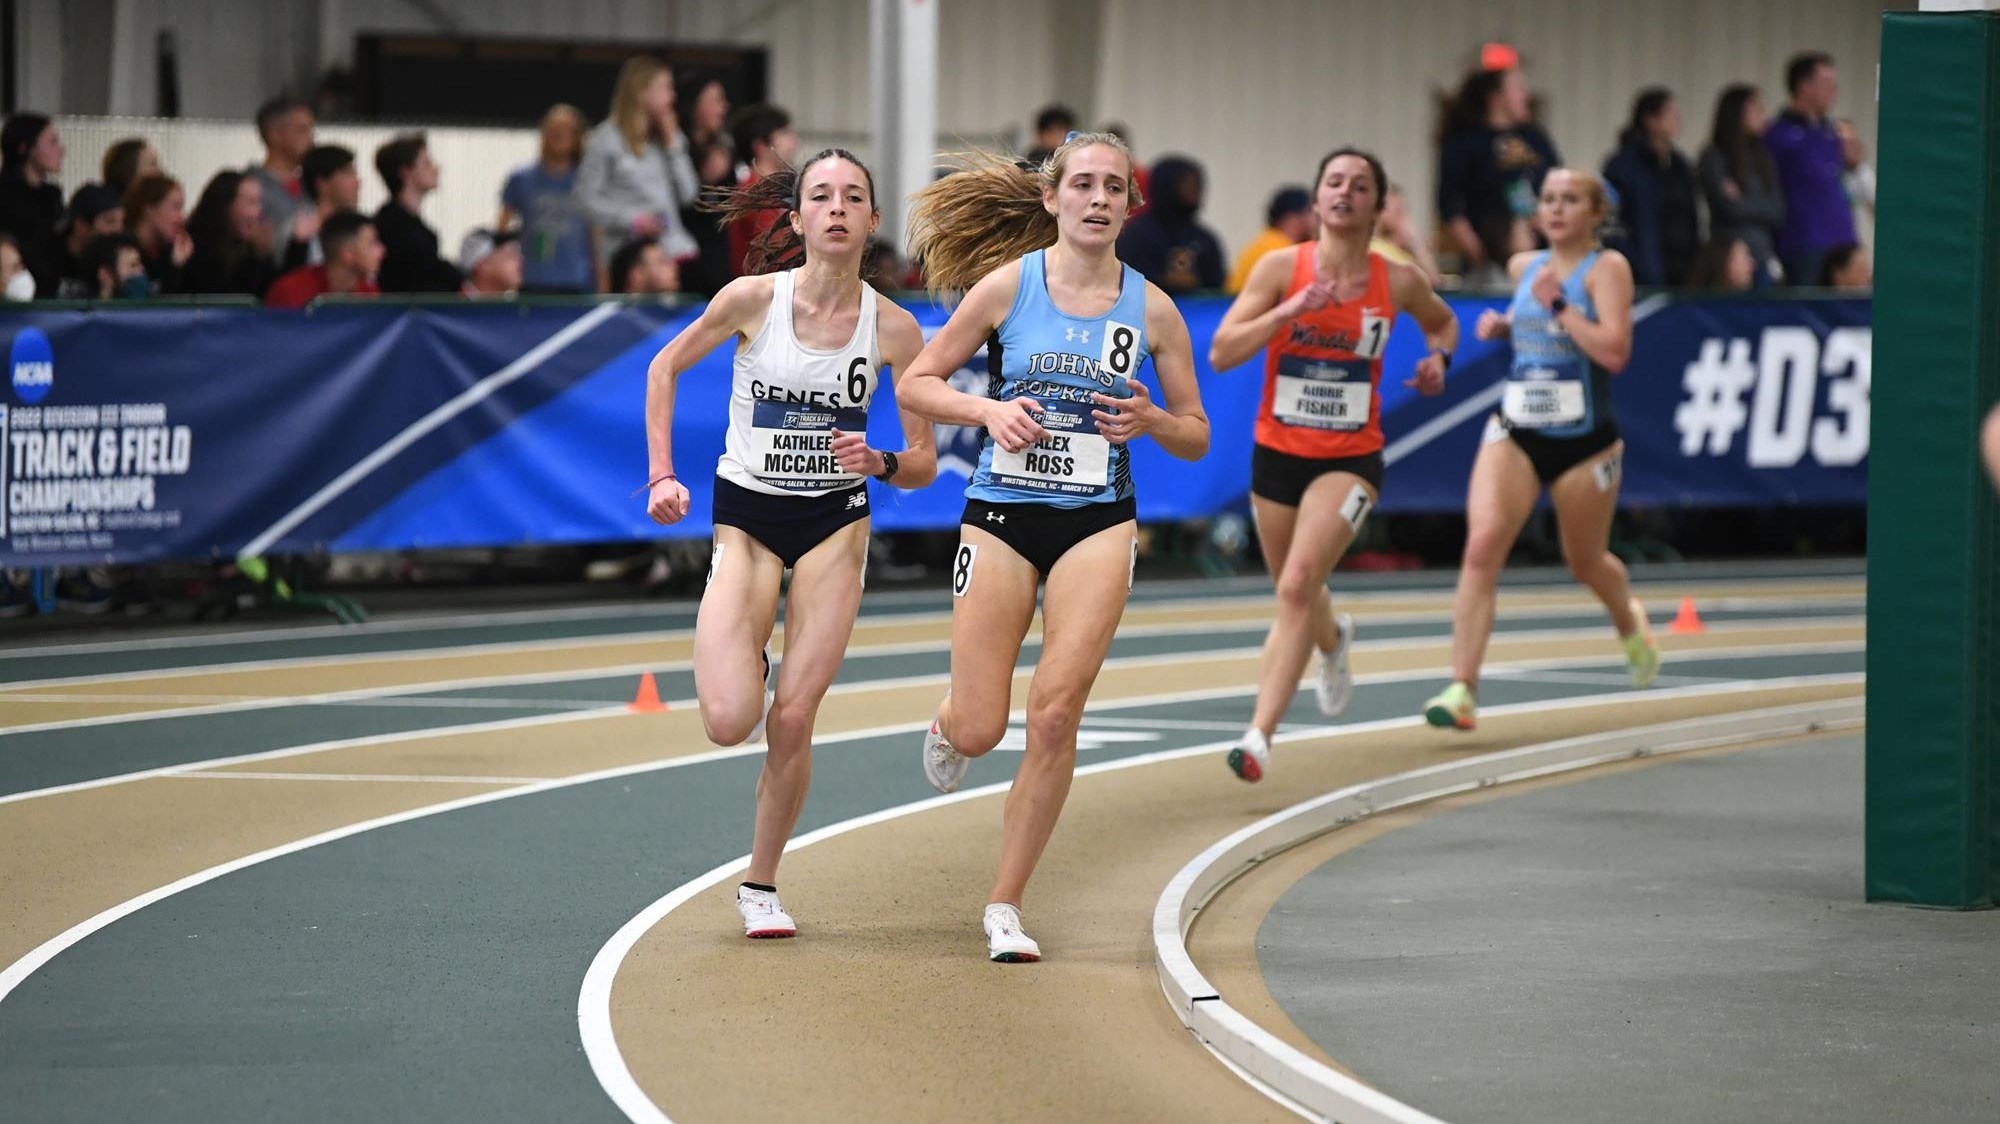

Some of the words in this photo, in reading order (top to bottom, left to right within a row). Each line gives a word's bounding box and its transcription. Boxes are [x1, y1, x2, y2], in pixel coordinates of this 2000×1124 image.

[1109, 327, 1134, 374] 8
[1370, 320, 1383, 355] 1
[847, 357, 868, 404] 6
[1027, 352, 1116, 388] JOHNS
[751, 379, 848, 409] GENES
[1296, 399, 1348, 417] FISHER
[1673, 325, 1872, 468] #D3
[1067, 417, 1083, 425] FIELD
[10, 430, 95, 478] TRACK
[98, 428, 118, 476] &
[120, 424, 193, 476] FIELD
[773, 434, 834, 451] KATHLEE
[1034, 435, 1070, 452] ALEX
[764, 453, 846, 474] MCCARE
[1025, 453, 1075, 476] ROSS
[10, 477, 155, 513] CHAMPIONSHIPS
[1049, 482, 1057, 490] NC
[1061, 484, 1081, 492] MARCH
[955, 546, 971, 594] 8
